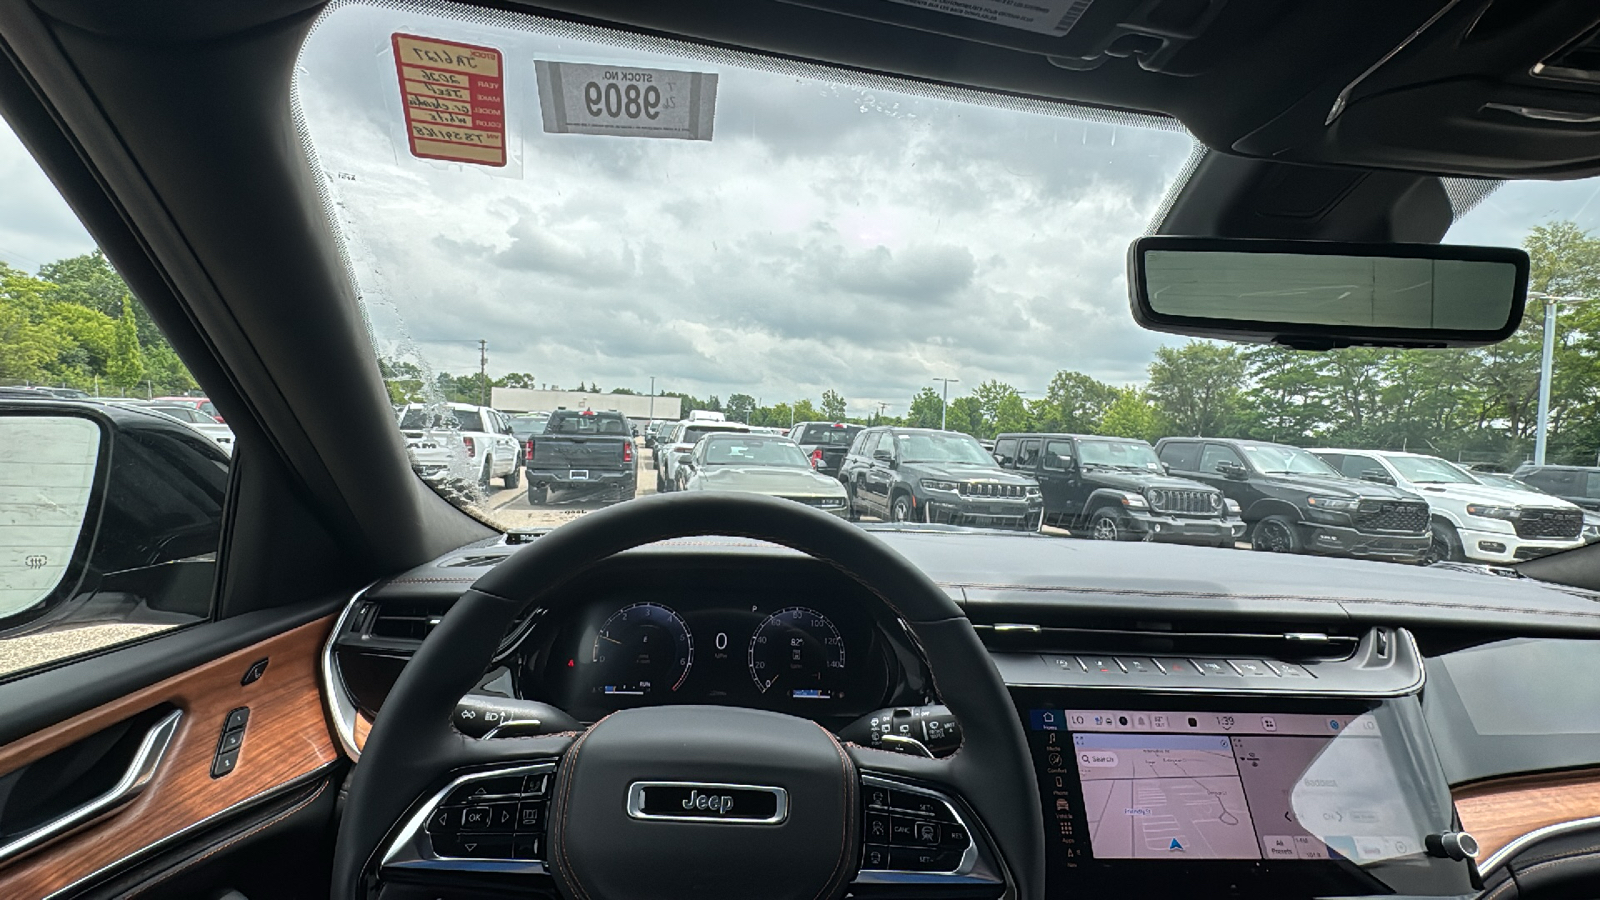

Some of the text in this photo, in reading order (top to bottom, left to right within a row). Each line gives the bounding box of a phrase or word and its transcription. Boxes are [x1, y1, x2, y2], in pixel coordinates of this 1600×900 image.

[715, 632, 728, 650] 0
[765, 680, 771, 688] 0
[1072, 716, 1084, 724] LO
[1216, 716, 1234, 726] 1:39
[682, 790, 734, 814] Jeep
[468, 813, 482, 822] OK
[894, 826, 910, 834] CANC
